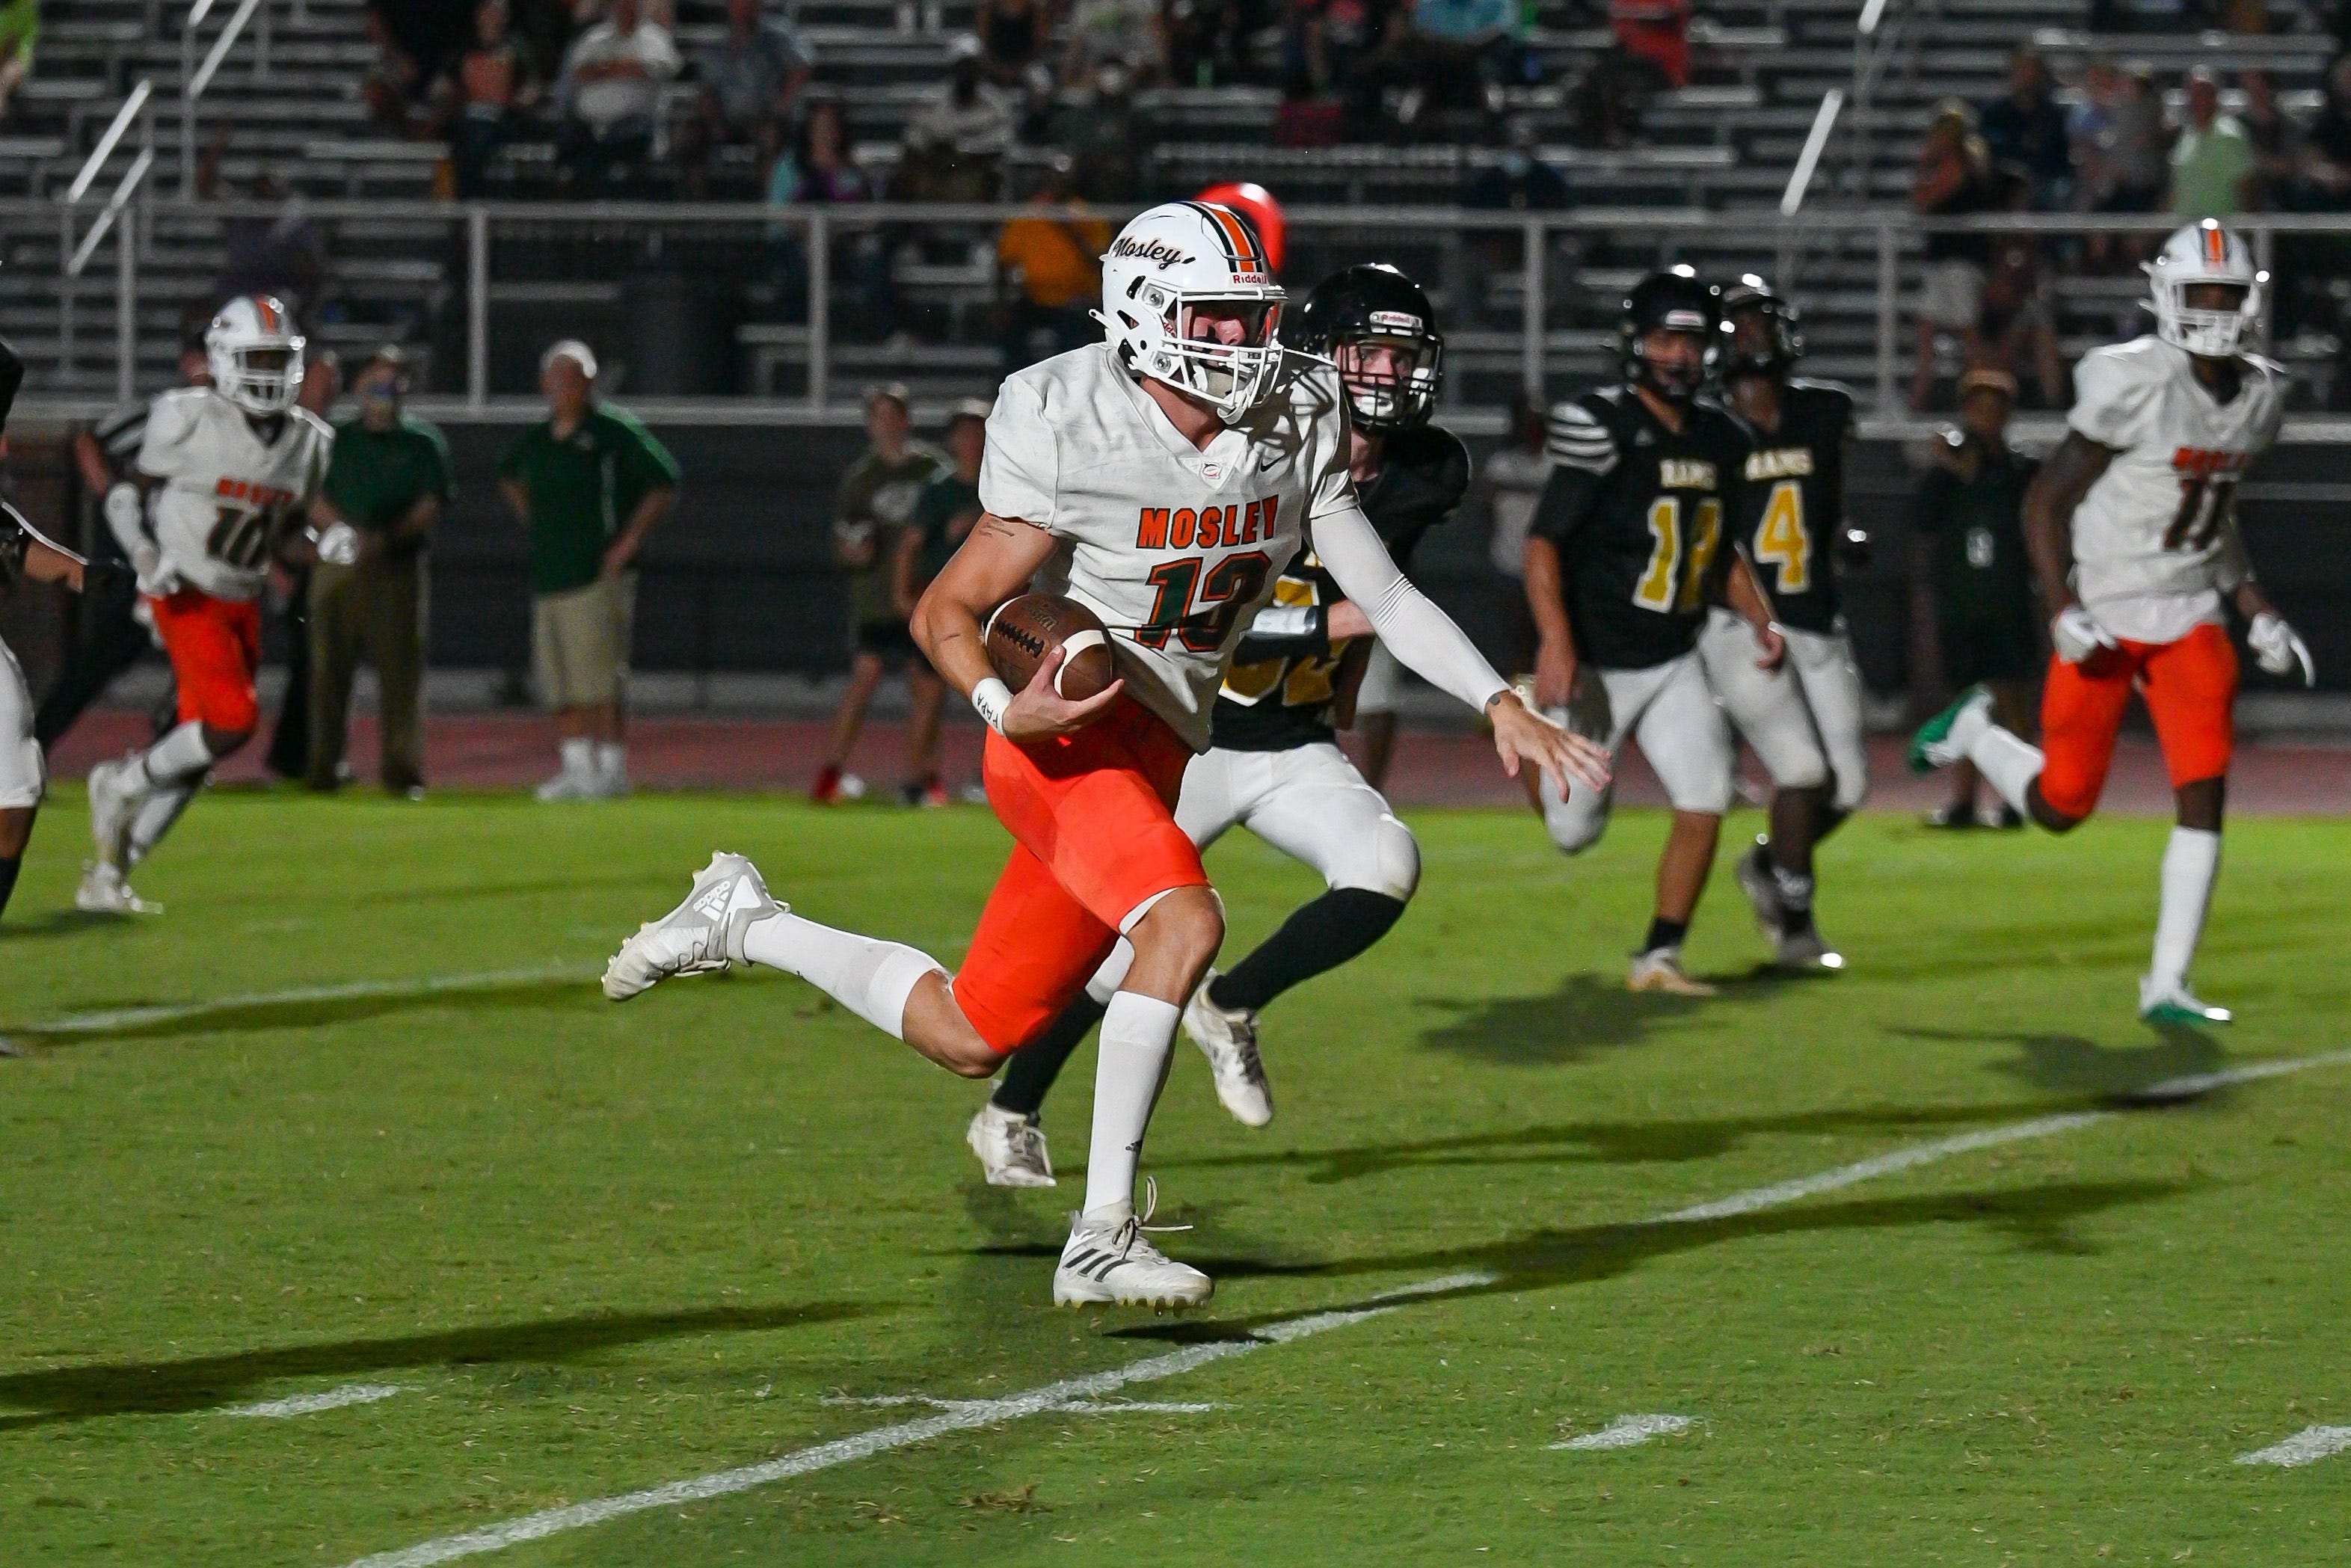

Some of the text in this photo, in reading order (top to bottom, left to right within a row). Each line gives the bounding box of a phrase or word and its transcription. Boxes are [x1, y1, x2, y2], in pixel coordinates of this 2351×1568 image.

[1112, 236, 1181, 271] Mosley
[1135, 494, 1279, 550] MOSLEY
[1753, 479, 1811, 596] 4
